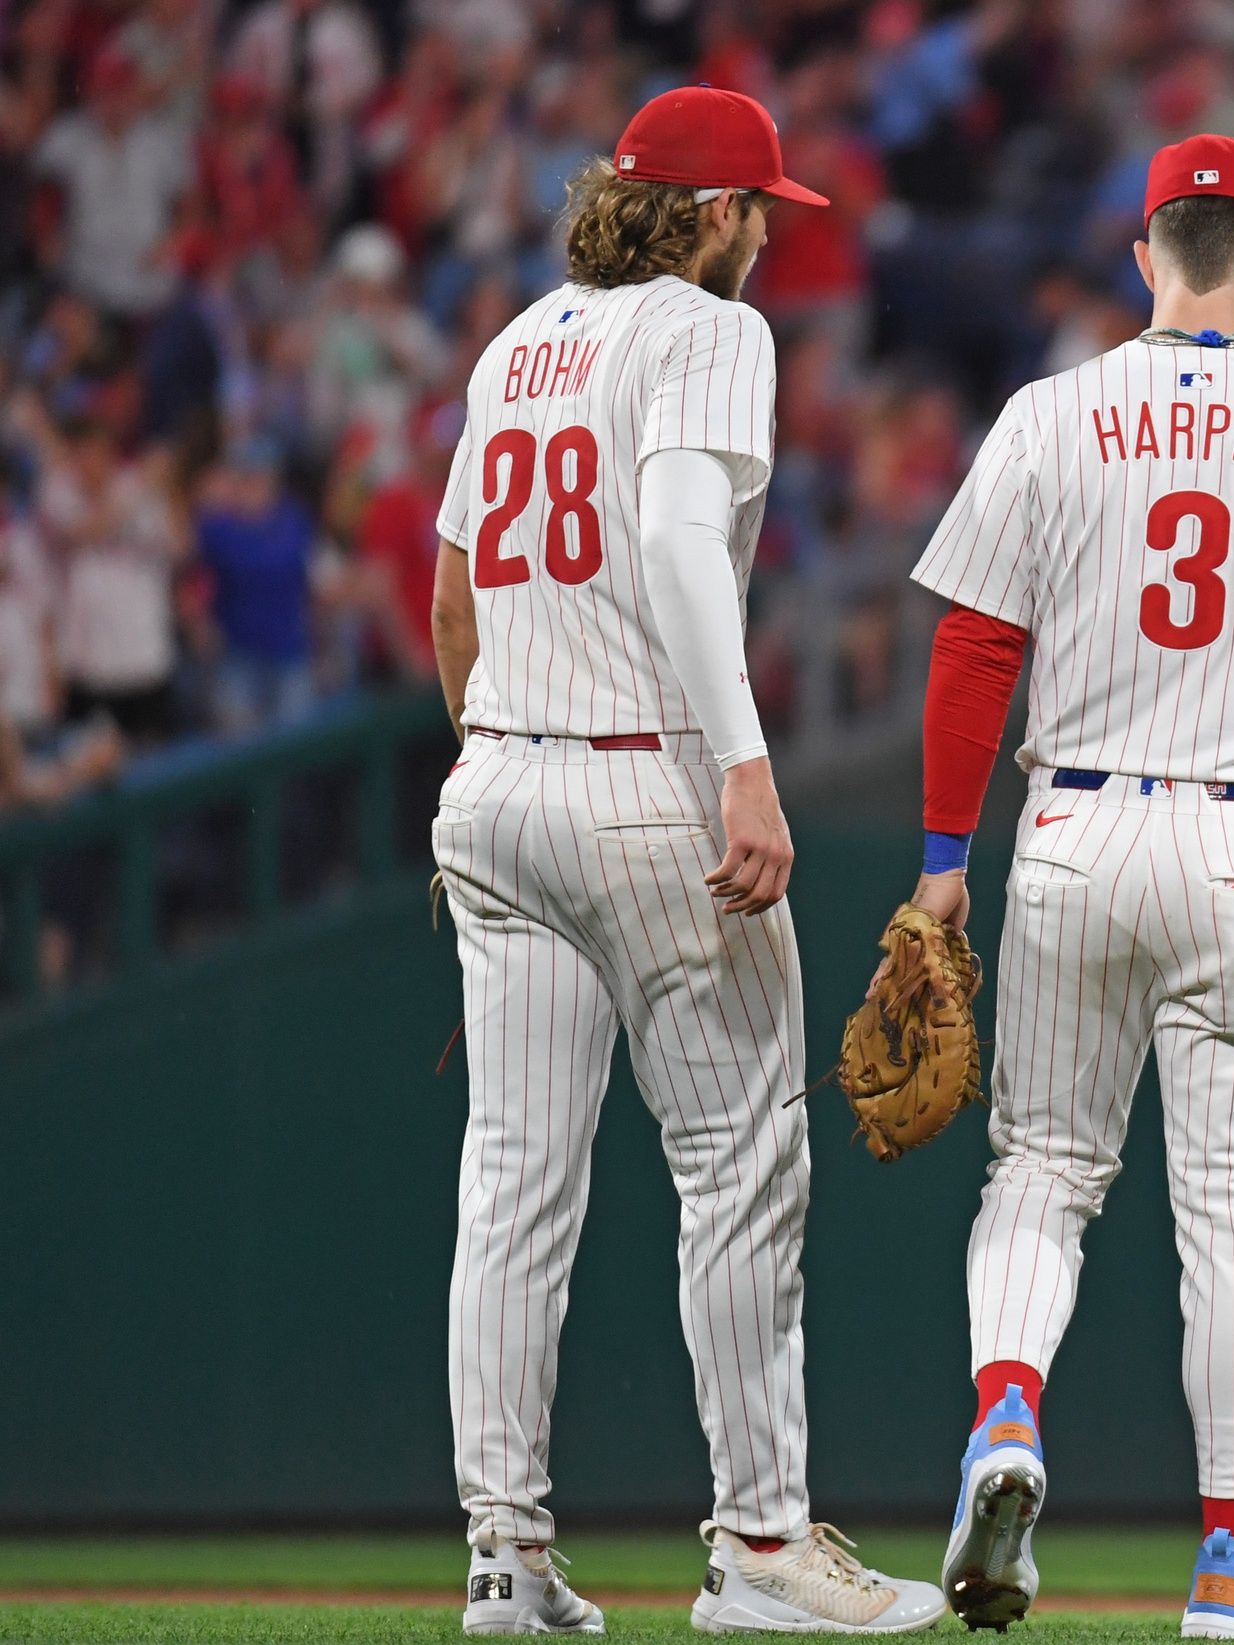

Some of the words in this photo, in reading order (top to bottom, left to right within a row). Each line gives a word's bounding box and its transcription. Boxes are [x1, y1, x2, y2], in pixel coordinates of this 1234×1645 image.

[504, 338, 601, 403] BOHM
[475, 424, 602, 589] 28
[1138, 489, 1232, 650] 3
